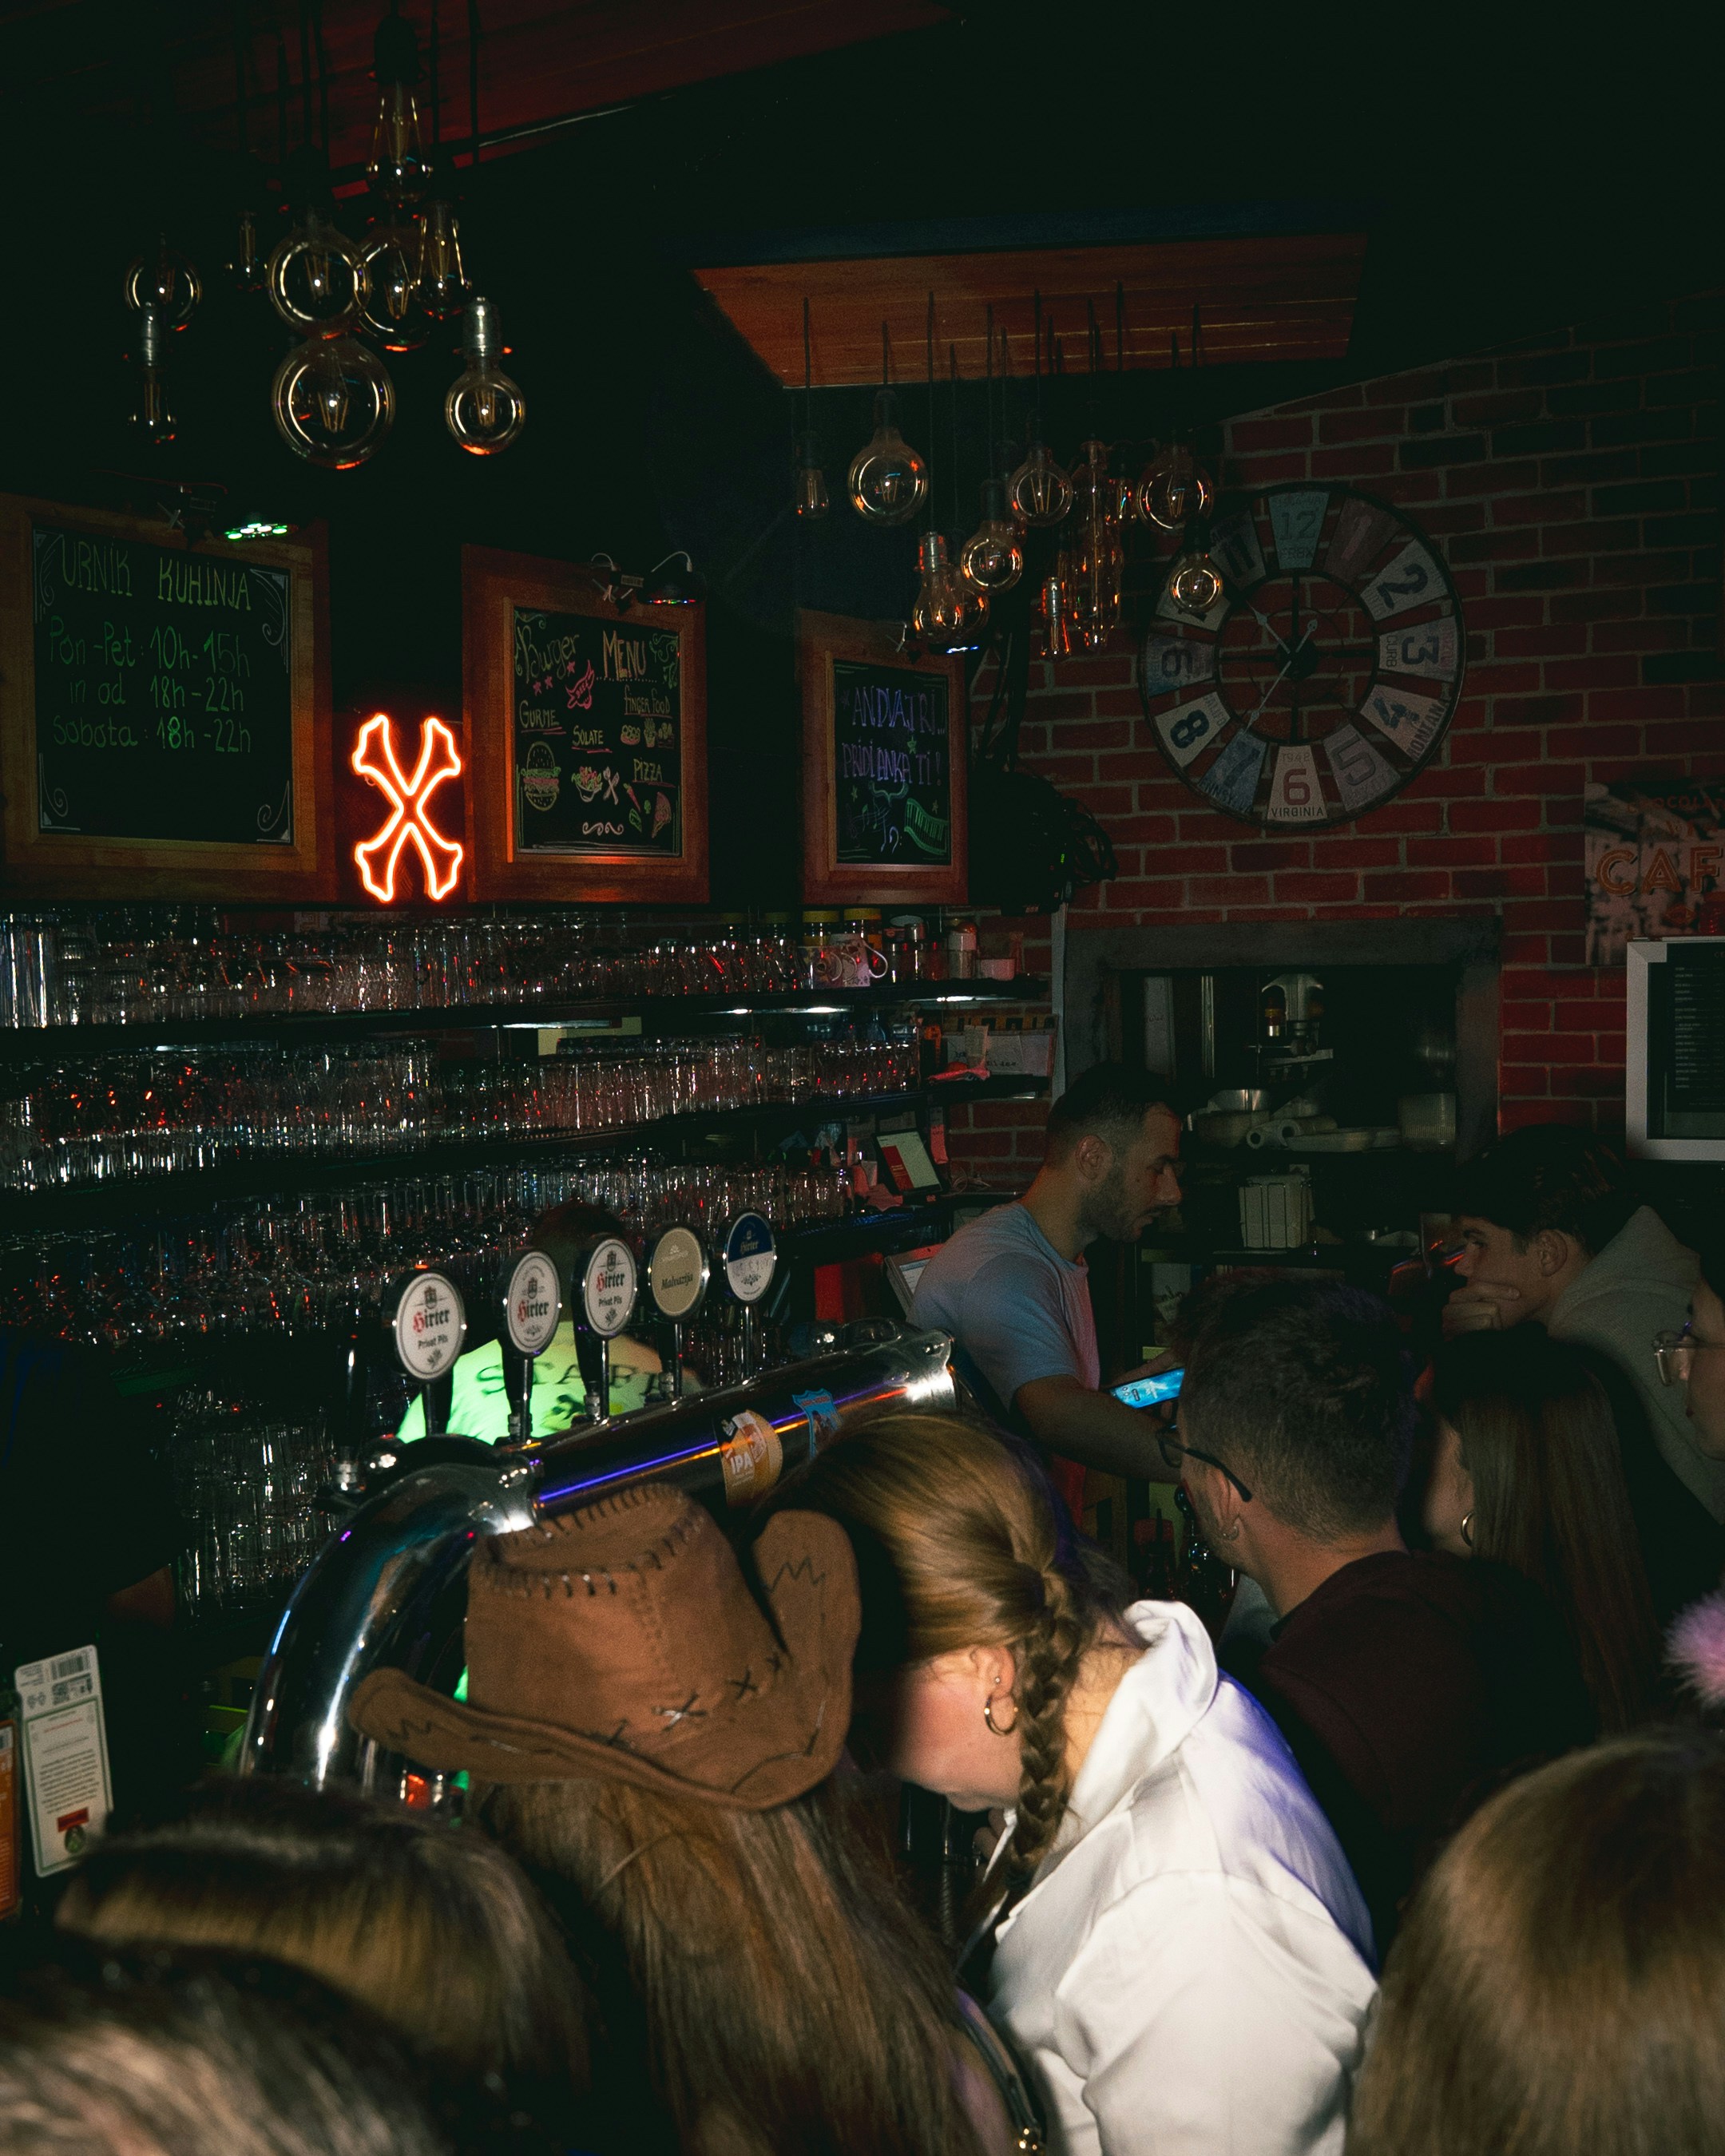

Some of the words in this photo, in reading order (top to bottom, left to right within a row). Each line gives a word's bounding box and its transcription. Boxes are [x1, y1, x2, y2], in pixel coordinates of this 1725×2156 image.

[1281, 511, 1317, 541] 12
[61, 537, 133, 597] URNIK
[157, 557, 252, 611] KUHINJA
[1377, 562, 1429, 610] 2
[517, 624, 581, 684] Burger
[602, 629, 648, 680] MENU
[1401, 638, 1440, 665] 3
[97, 673, 126, 705] od
[519, 700, 560, 728] GURME
[572, 724, 604, 747] SOLATE
[1171, 709, 1209, 749] 8
[632, 758, 664, 782] PIZZA
[1283, 768, 1311, 806] 6
[1271, 807, 1324, 818] VIRGINIA
[597, 1270, 625, 1292] Hirter
[412, 1308, 450, 1333] Hirter
[518, 1299, 549, 1322] Hirter
